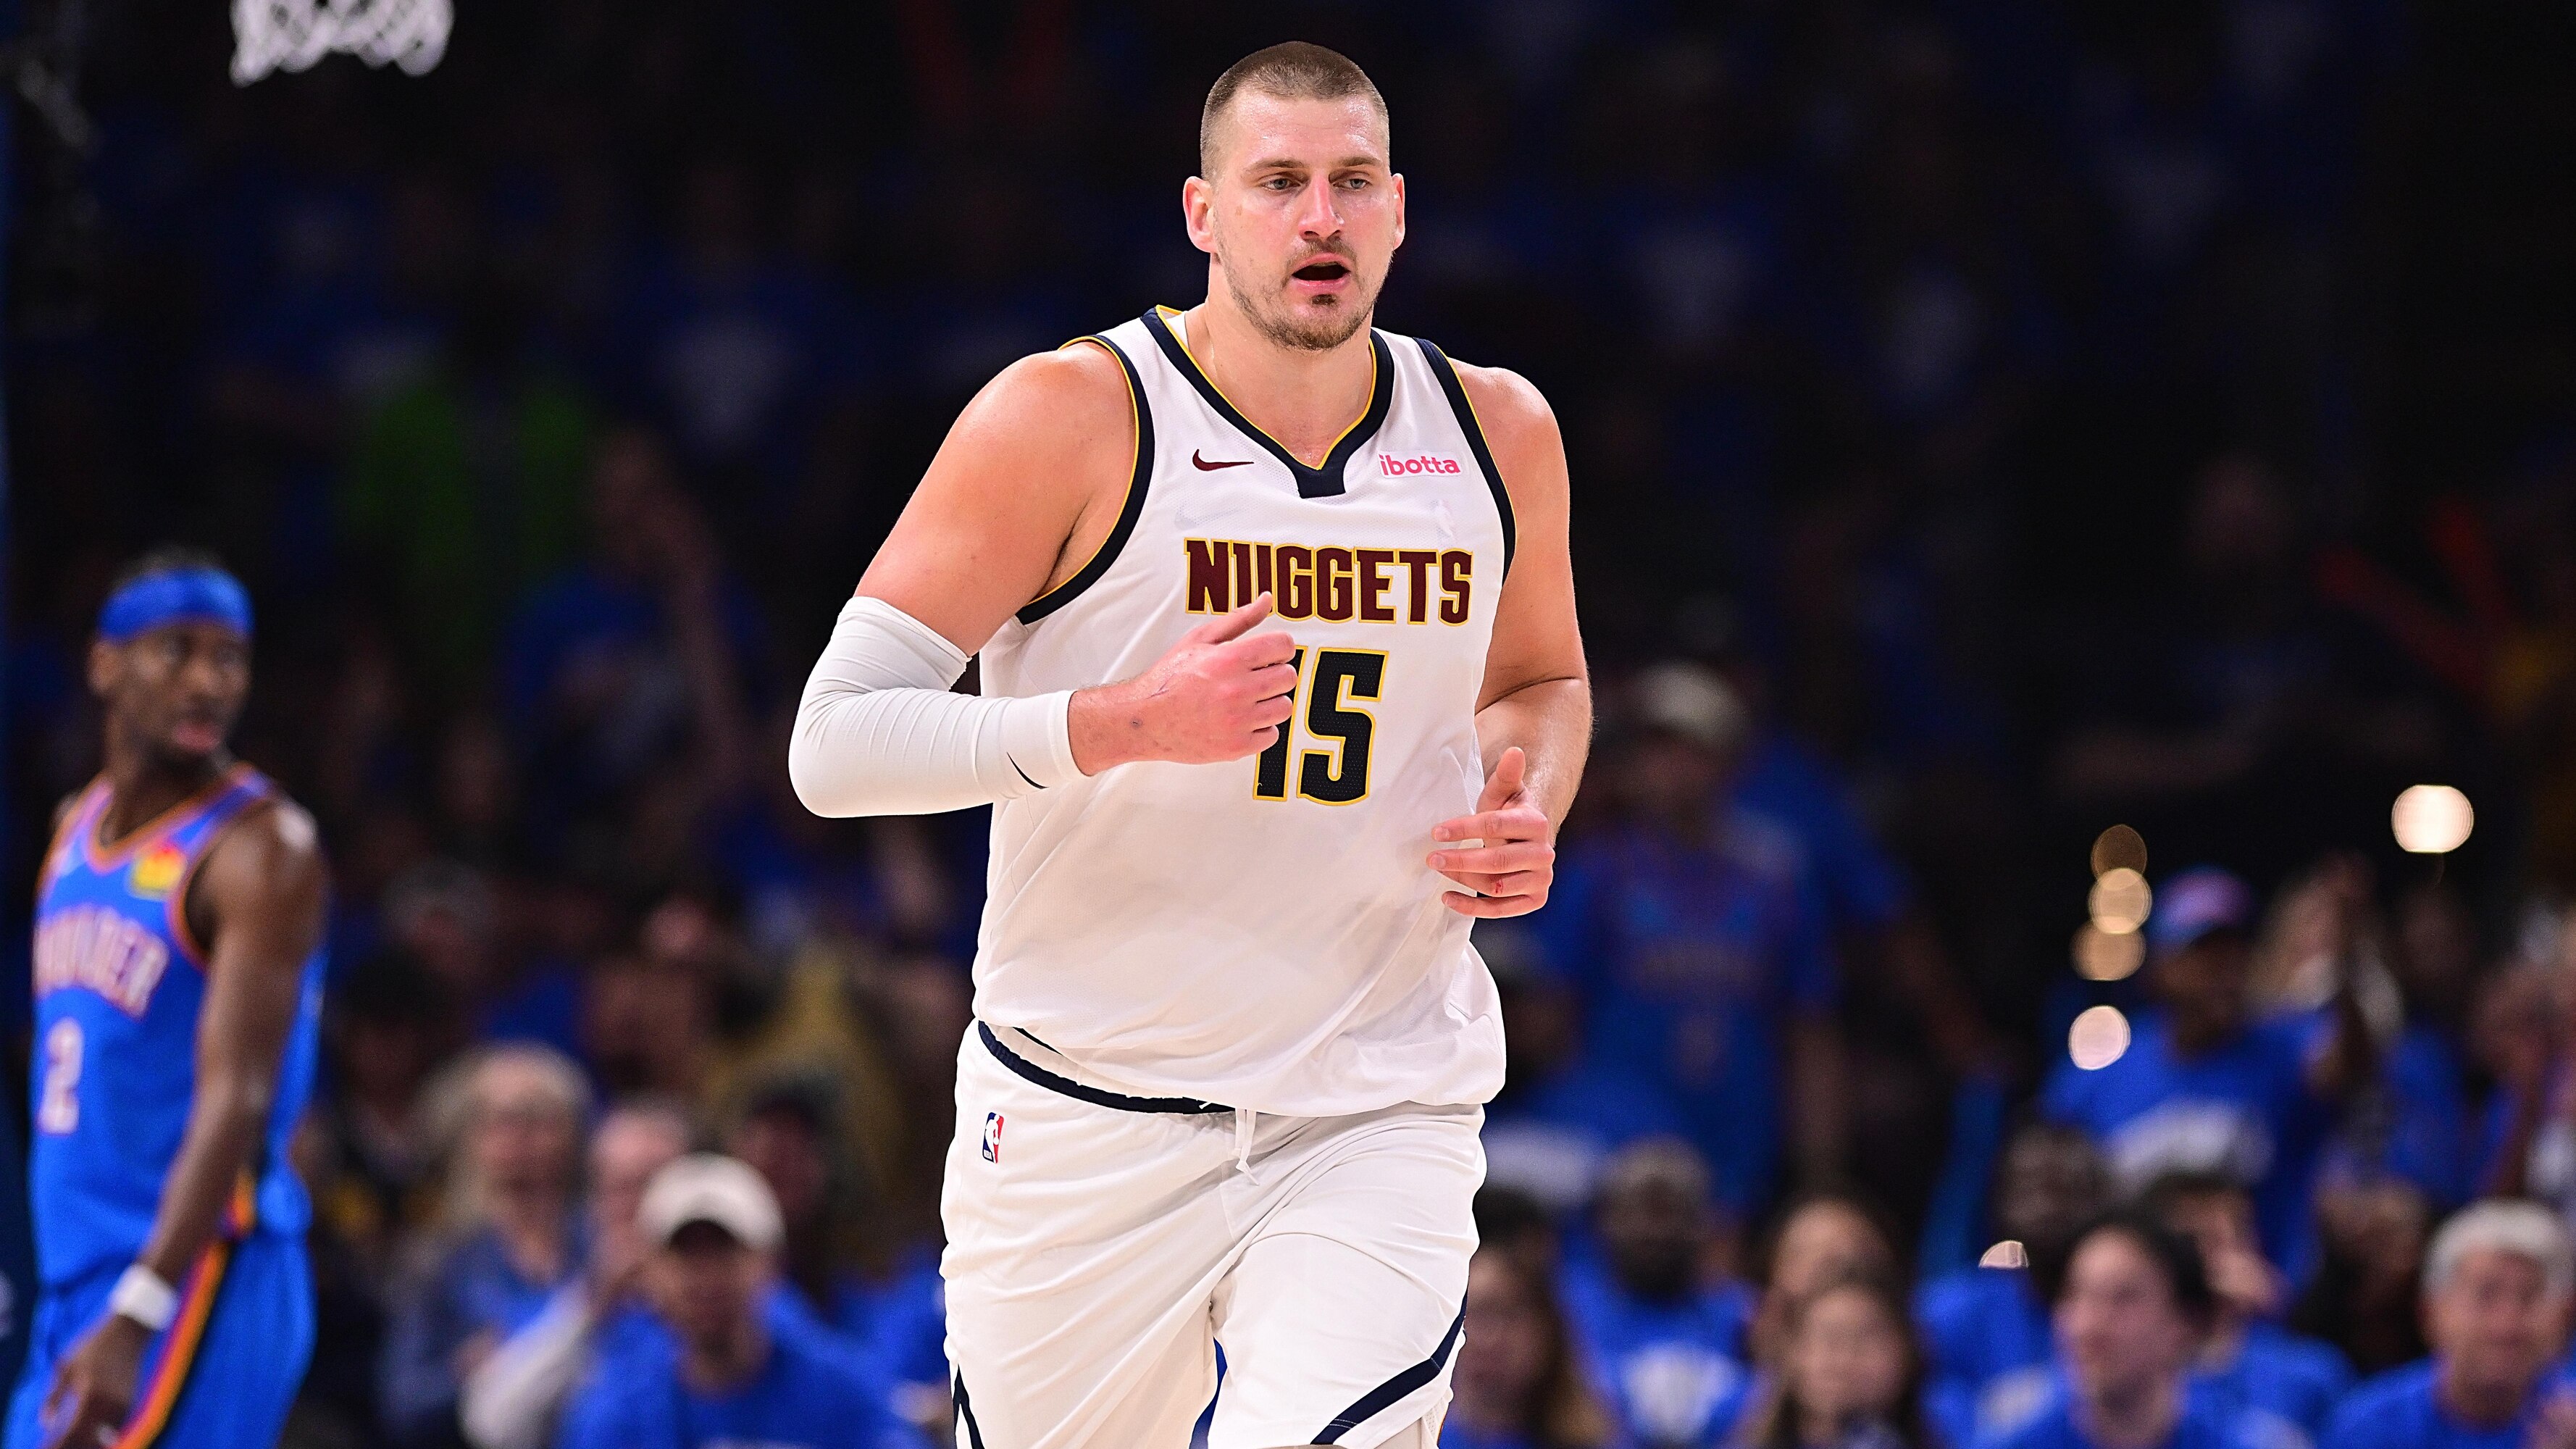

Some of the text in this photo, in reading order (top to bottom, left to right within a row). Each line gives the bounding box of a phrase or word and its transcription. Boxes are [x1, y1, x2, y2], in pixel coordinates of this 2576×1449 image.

[1378, 454, 1461, 476] ibotta
[1184, 538, 1474, 627] NUGGETS
[1253, 645, 1389, 806] 15
[39, 1017, 84, 1134] 2
